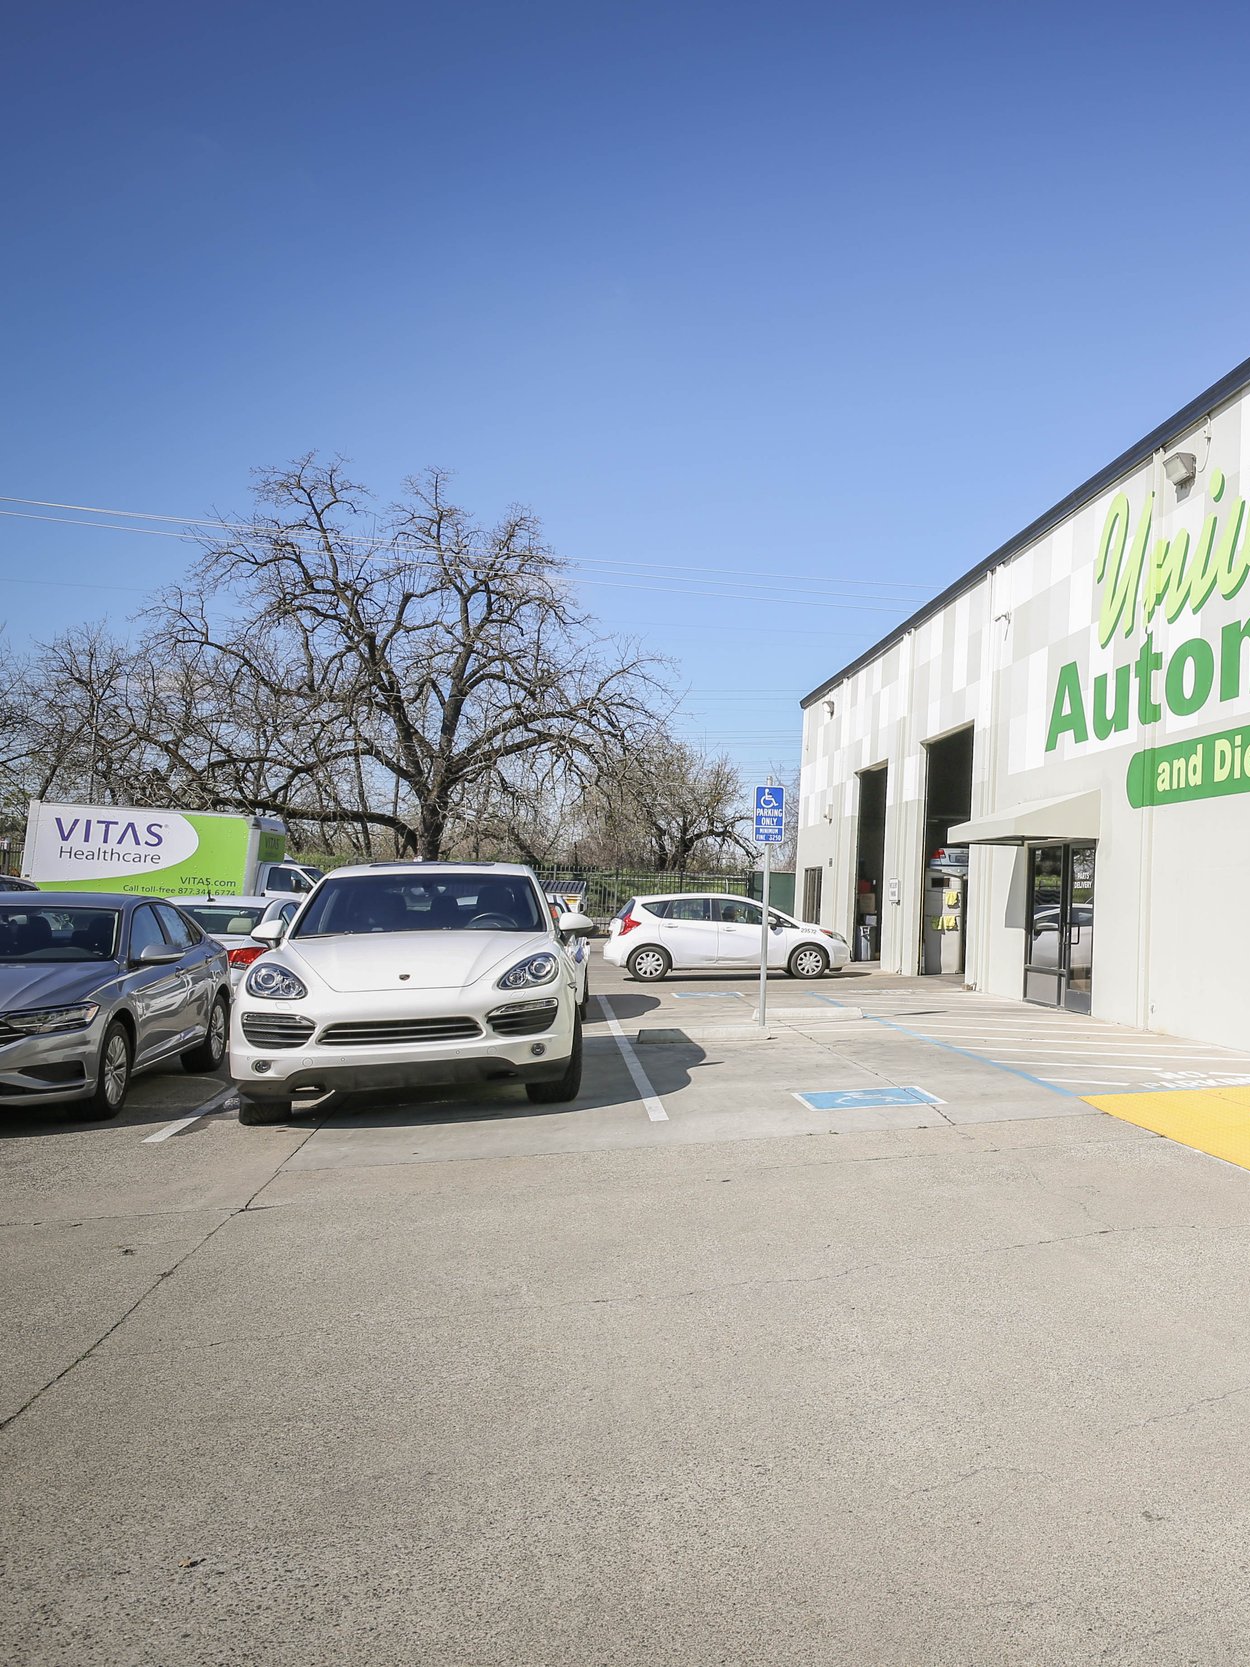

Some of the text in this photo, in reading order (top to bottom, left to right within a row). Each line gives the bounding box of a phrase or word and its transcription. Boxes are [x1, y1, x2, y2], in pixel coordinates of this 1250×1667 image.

[1156, 743, 1203, 793] and
[756, 808, 783, 818] PARKING
[761, 817, 778, 826] ONLY
[55, 817, 164, 847] VITAS
[264, 836, 280, 850] VITAS
[59, 846, 161, 865] Healthcare
[180, 876, 237, 888] VITAS.com
[1073, 881, 1092, 889] DELIVERY
[123, 884, 139, 892] Call
[141, 886, 176, 894] toll-free
[1152, 1070, 1208, 1080] NO
